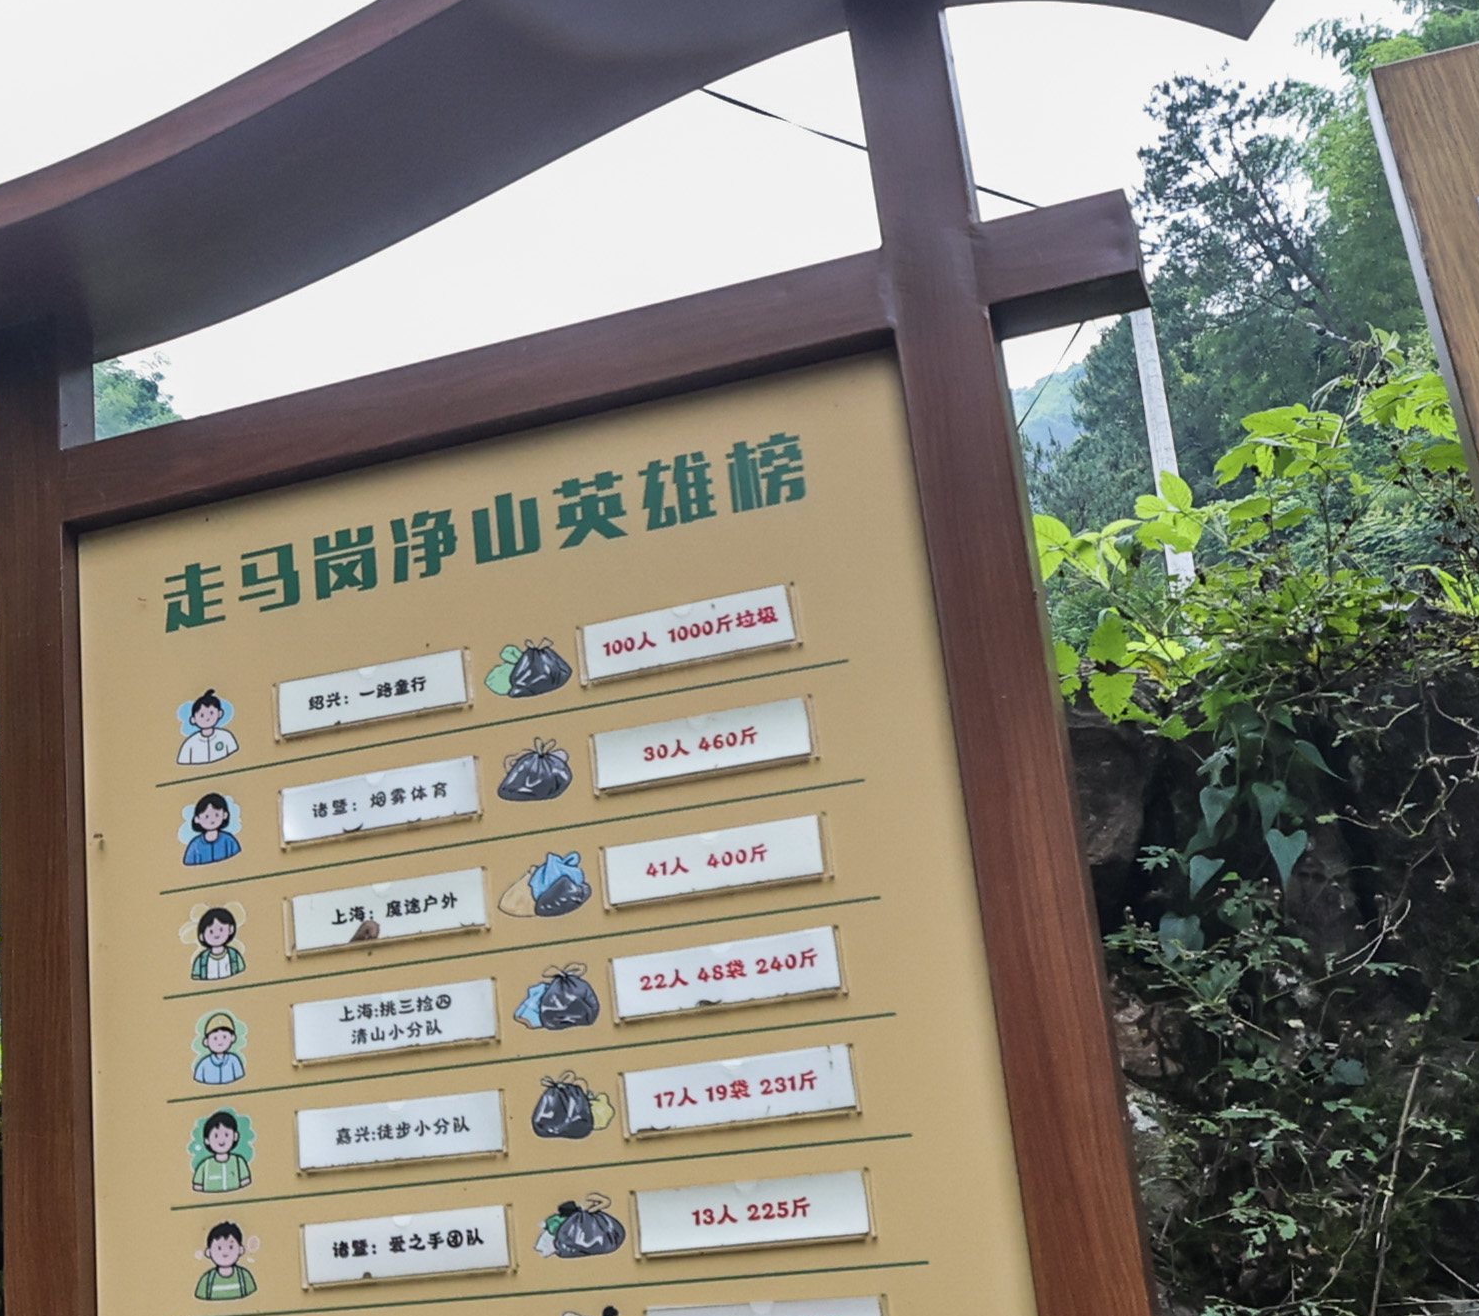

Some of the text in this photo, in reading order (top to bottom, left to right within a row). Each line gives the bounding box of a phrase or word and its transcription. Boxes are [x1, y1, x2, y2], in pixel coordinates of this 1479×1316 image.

[163, 431, 807, 633] 走马岗净山英雄榜
[603, 606, 779, 657] 100人 1000斤垃圾
[643, 726, 758, 762] 30人 460斤
[646, 843, 769, 878] 41人 400斤
[640, 947, 818, 991] 22人 48袋 240斤
[350, 1018, 444, 1045] 清山小分队
[653, 1069, 818, 1109] 17人 19袋 231斤
[692, 1196, 811, 1226] 13人 225斤
